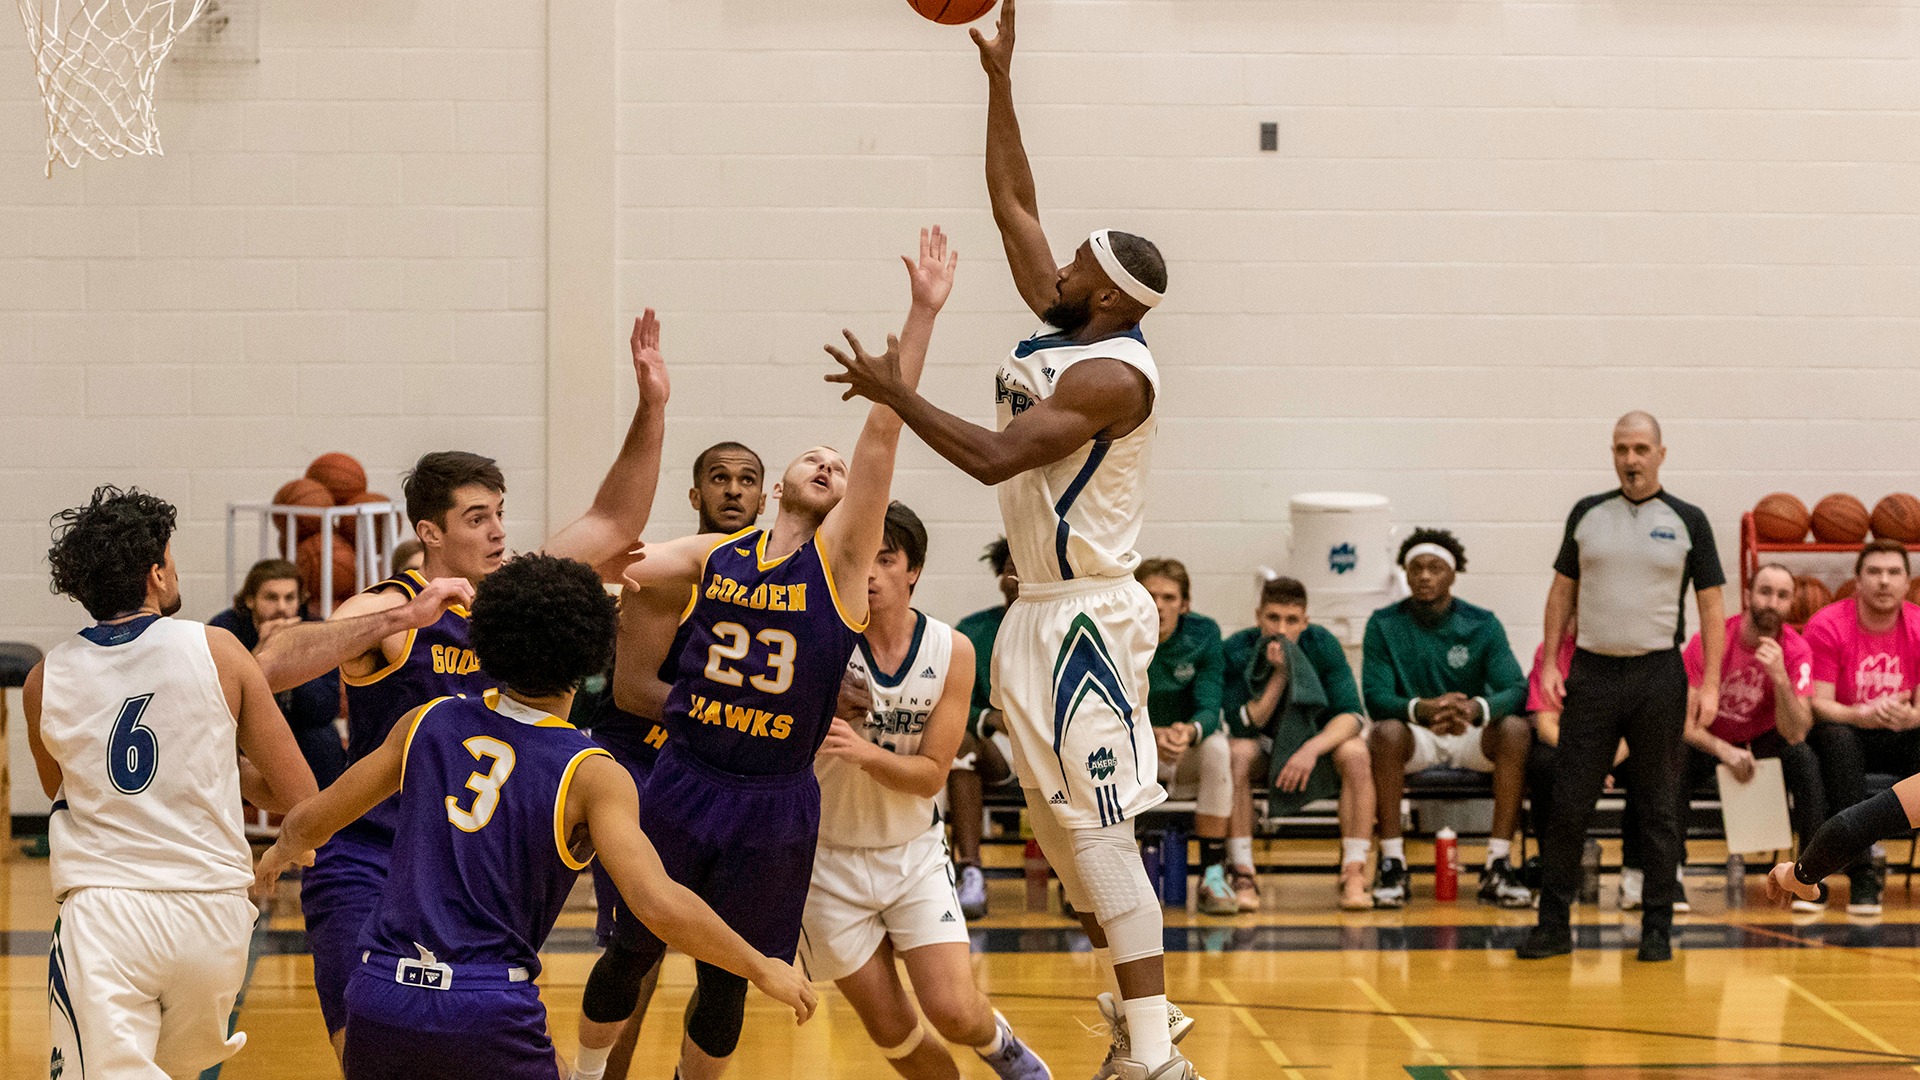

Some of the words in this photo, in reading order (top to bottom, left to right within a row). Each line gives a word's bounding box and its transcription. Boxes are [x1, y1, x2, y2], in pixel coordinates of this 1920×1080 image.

[705, 573, 807, 611] GOLDEN
[704, 621, 798, 695] 23
[688, 694, 794, 741] HAWKS
[876, 696, 932, 708] ISING
[106, 692, 159, 796] 6
[1085, 757, 1118, 771] LAKERS
[444, 735, 516, 833] 3
